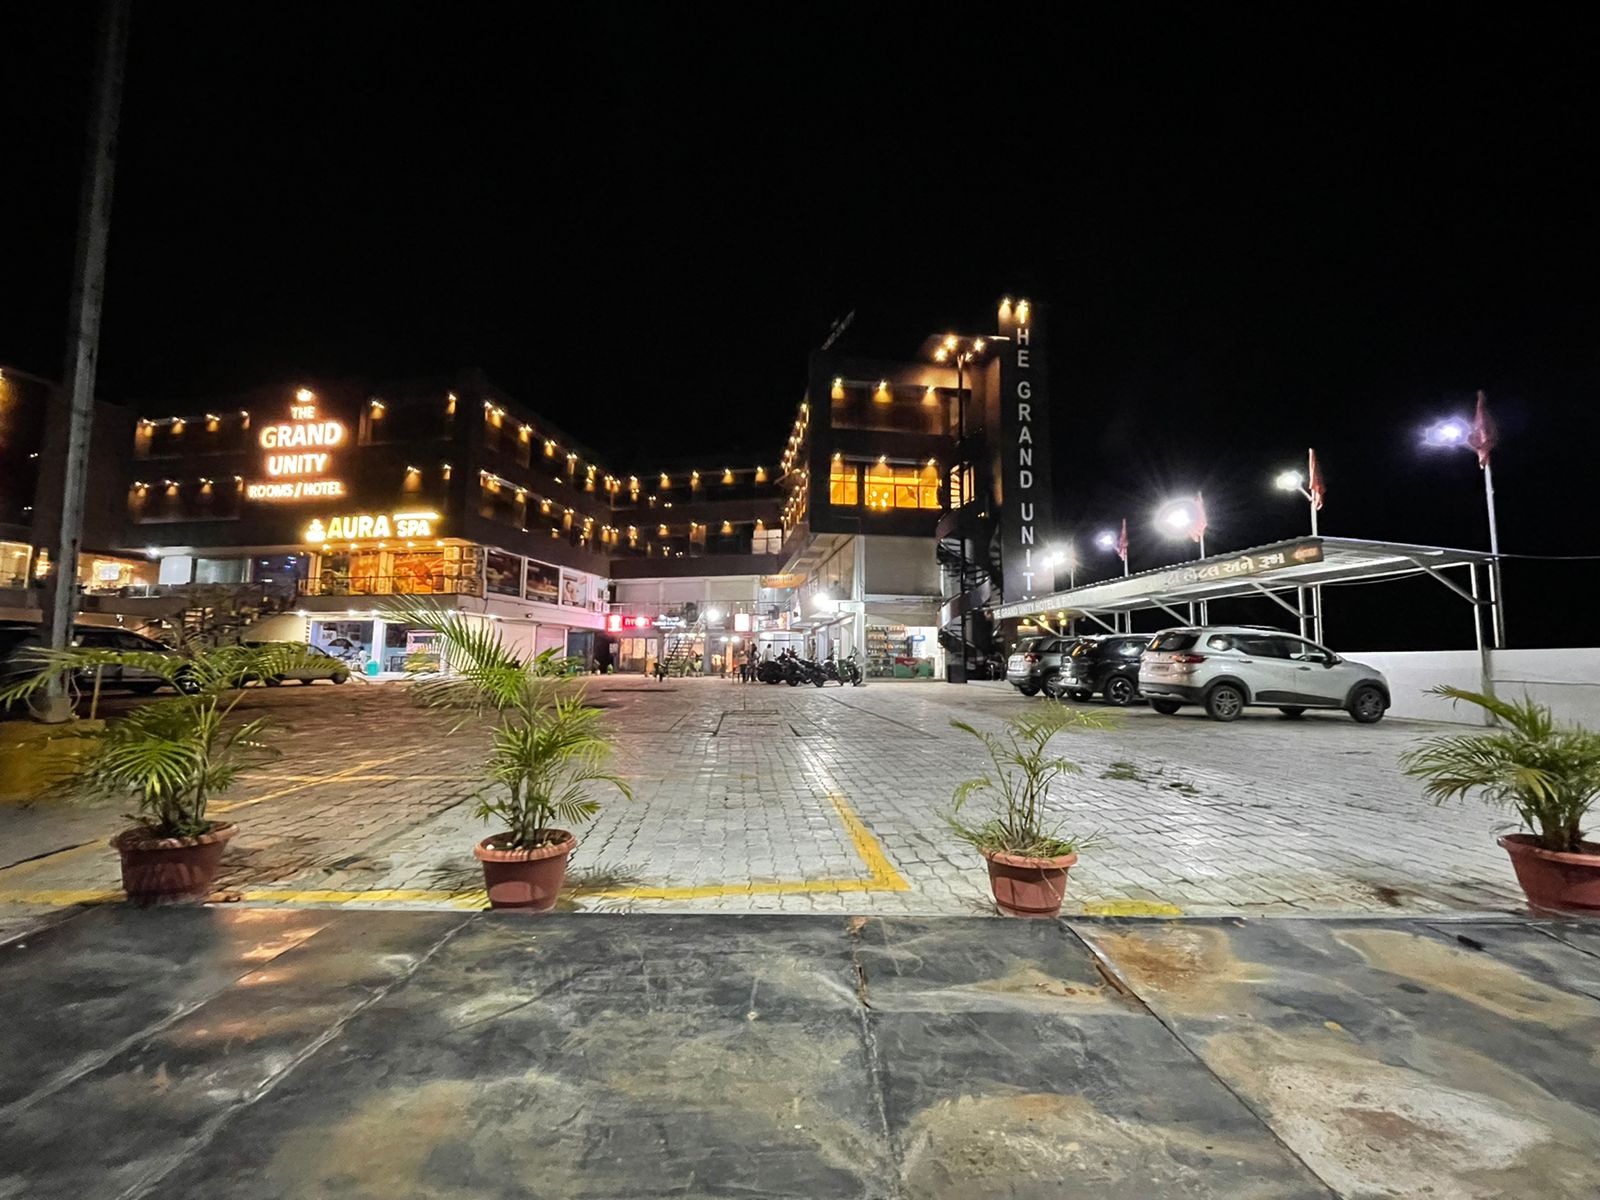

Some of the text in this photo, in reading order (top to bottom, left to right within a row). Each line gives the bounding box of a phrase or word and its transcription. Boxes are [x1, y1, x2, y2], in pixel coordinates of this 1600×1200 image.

[291, 406, 315, 419] THE
[260, 422, 343, 448] GRAND
[1017, 381, 1033, 489] GRAND
[267, 453, 328, 475] UNITY
[327, 515, 431, 538] AURA SPA
[1020, 502, 1036, 600] UNIT
